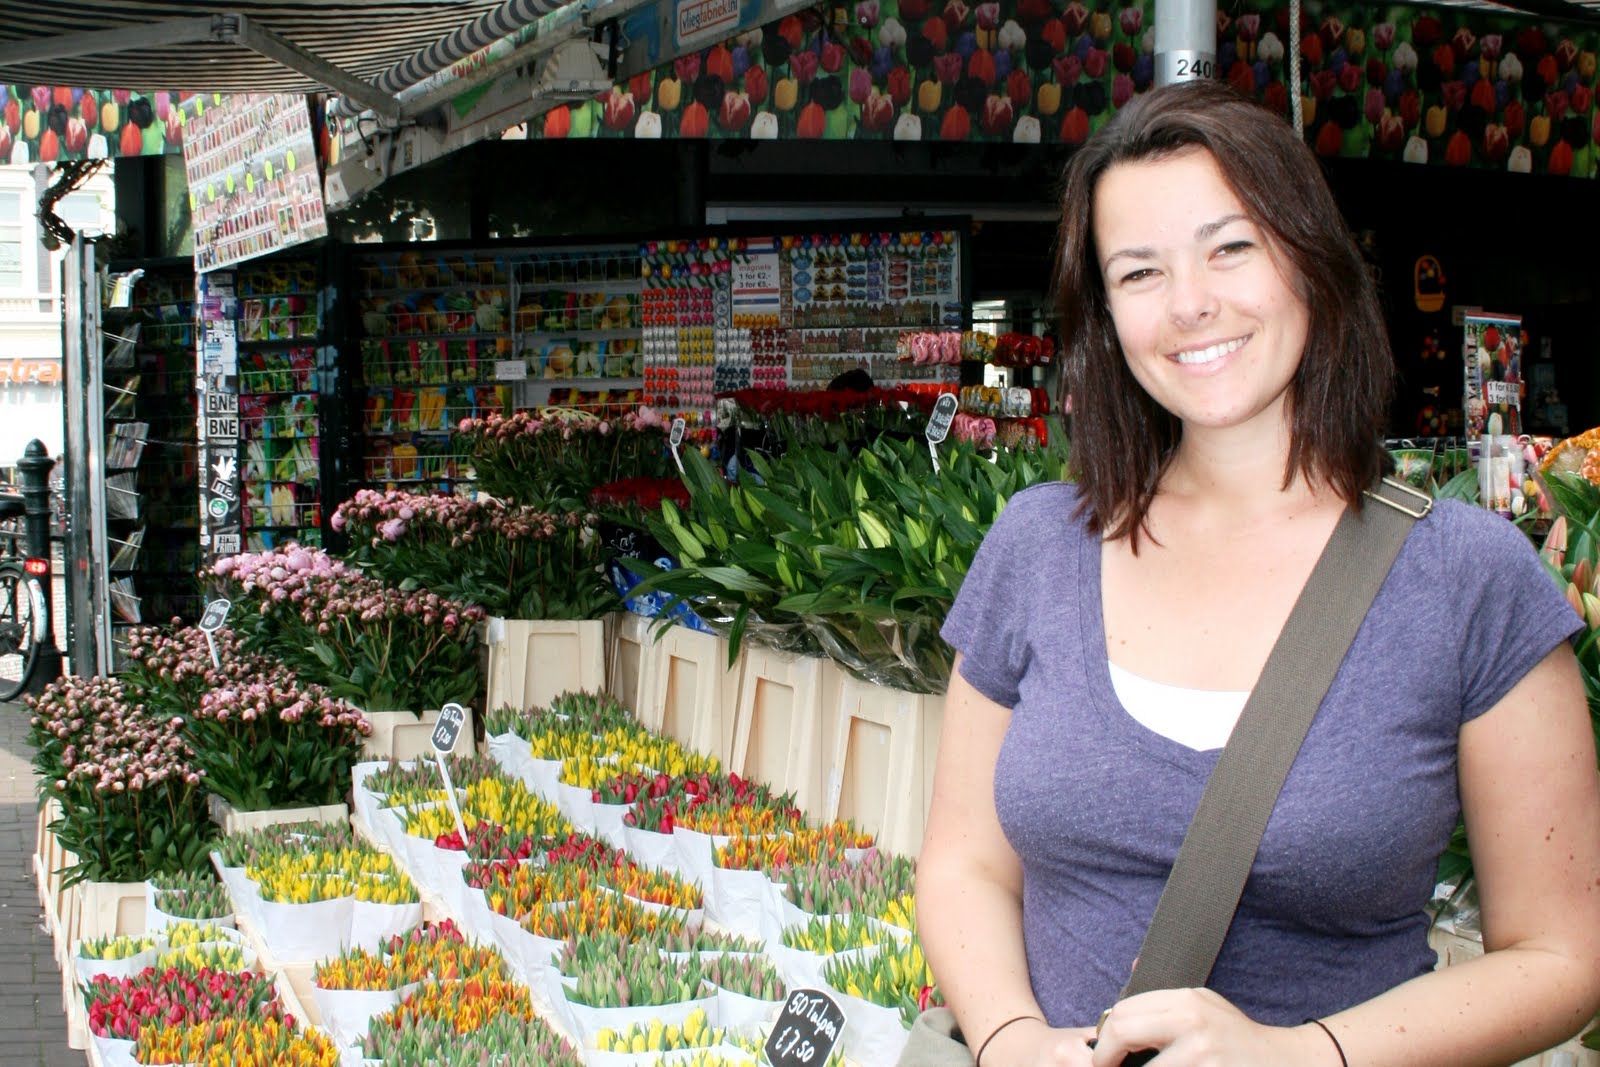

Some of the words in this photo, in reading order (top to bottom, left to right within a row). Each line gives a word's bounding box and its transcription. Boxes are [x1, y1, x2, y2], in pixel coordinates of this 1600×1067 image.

[745, 272, 756, 280] for
[1495, 382, 1505, 392] for
[209, 395, 237, 411] BNE
[1496, 394, 1506, 403] for
[210, 419, 237, 435] BNE
[788, 992, 809, 1016] 50
[806, 998, 837, 1042] Tulpen
